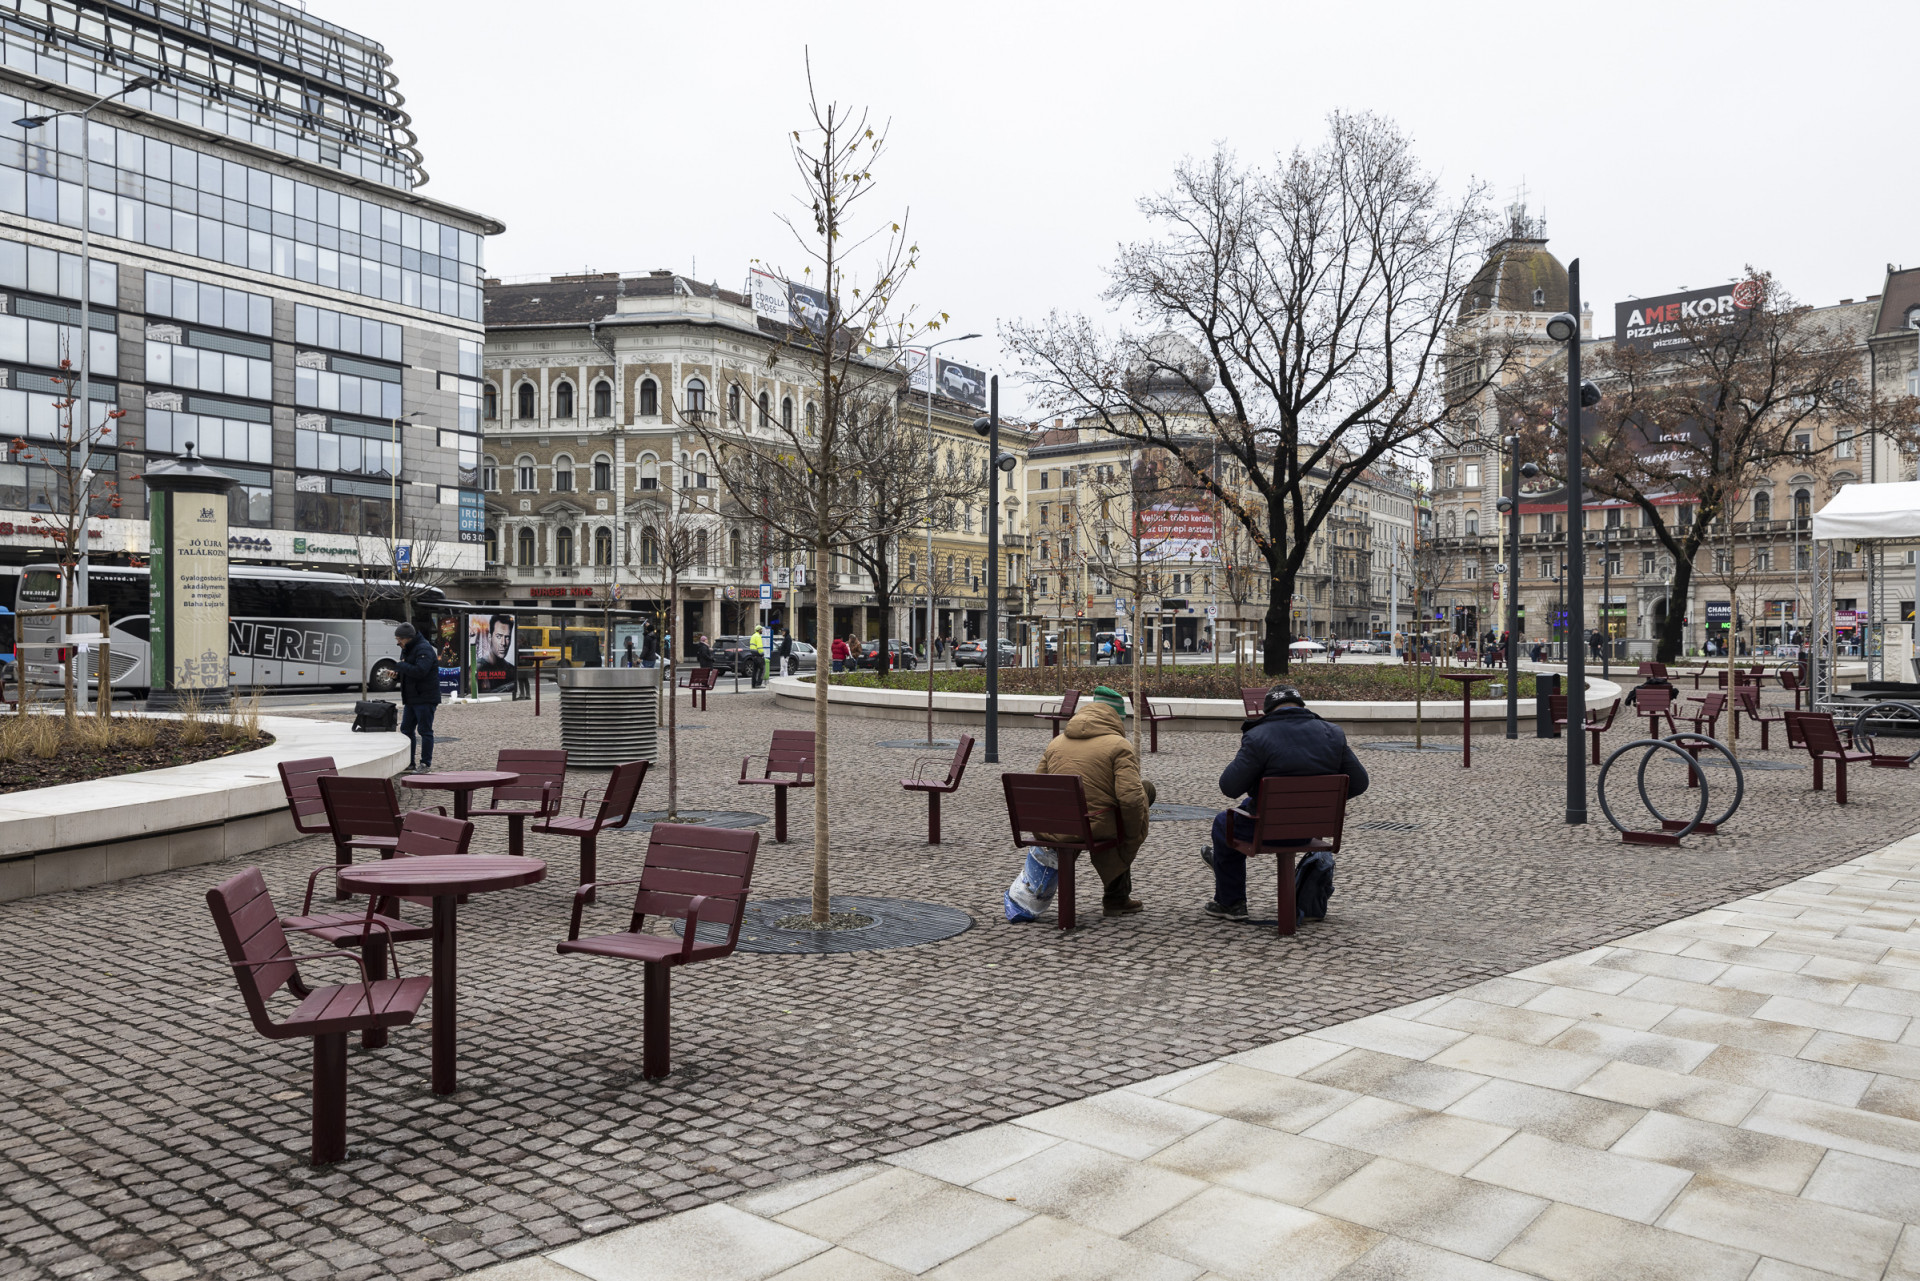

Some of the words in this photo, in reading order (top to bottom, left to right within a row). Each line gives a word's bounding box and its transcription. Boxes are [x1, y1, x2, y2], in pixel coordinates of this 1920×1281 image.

[755, 292, 785, 308] COROLLA
[755, 301, 777, 314] CROSS
[189, 538, 201, 547] JÓ
[307, 544, 358, 556] Groupama
[530, 587, 567, 597] BURGER
[569, 587, 593, 597] KING
[740, 589, 760, 598] BURGE
[228, 621, 351, 665] NERED
